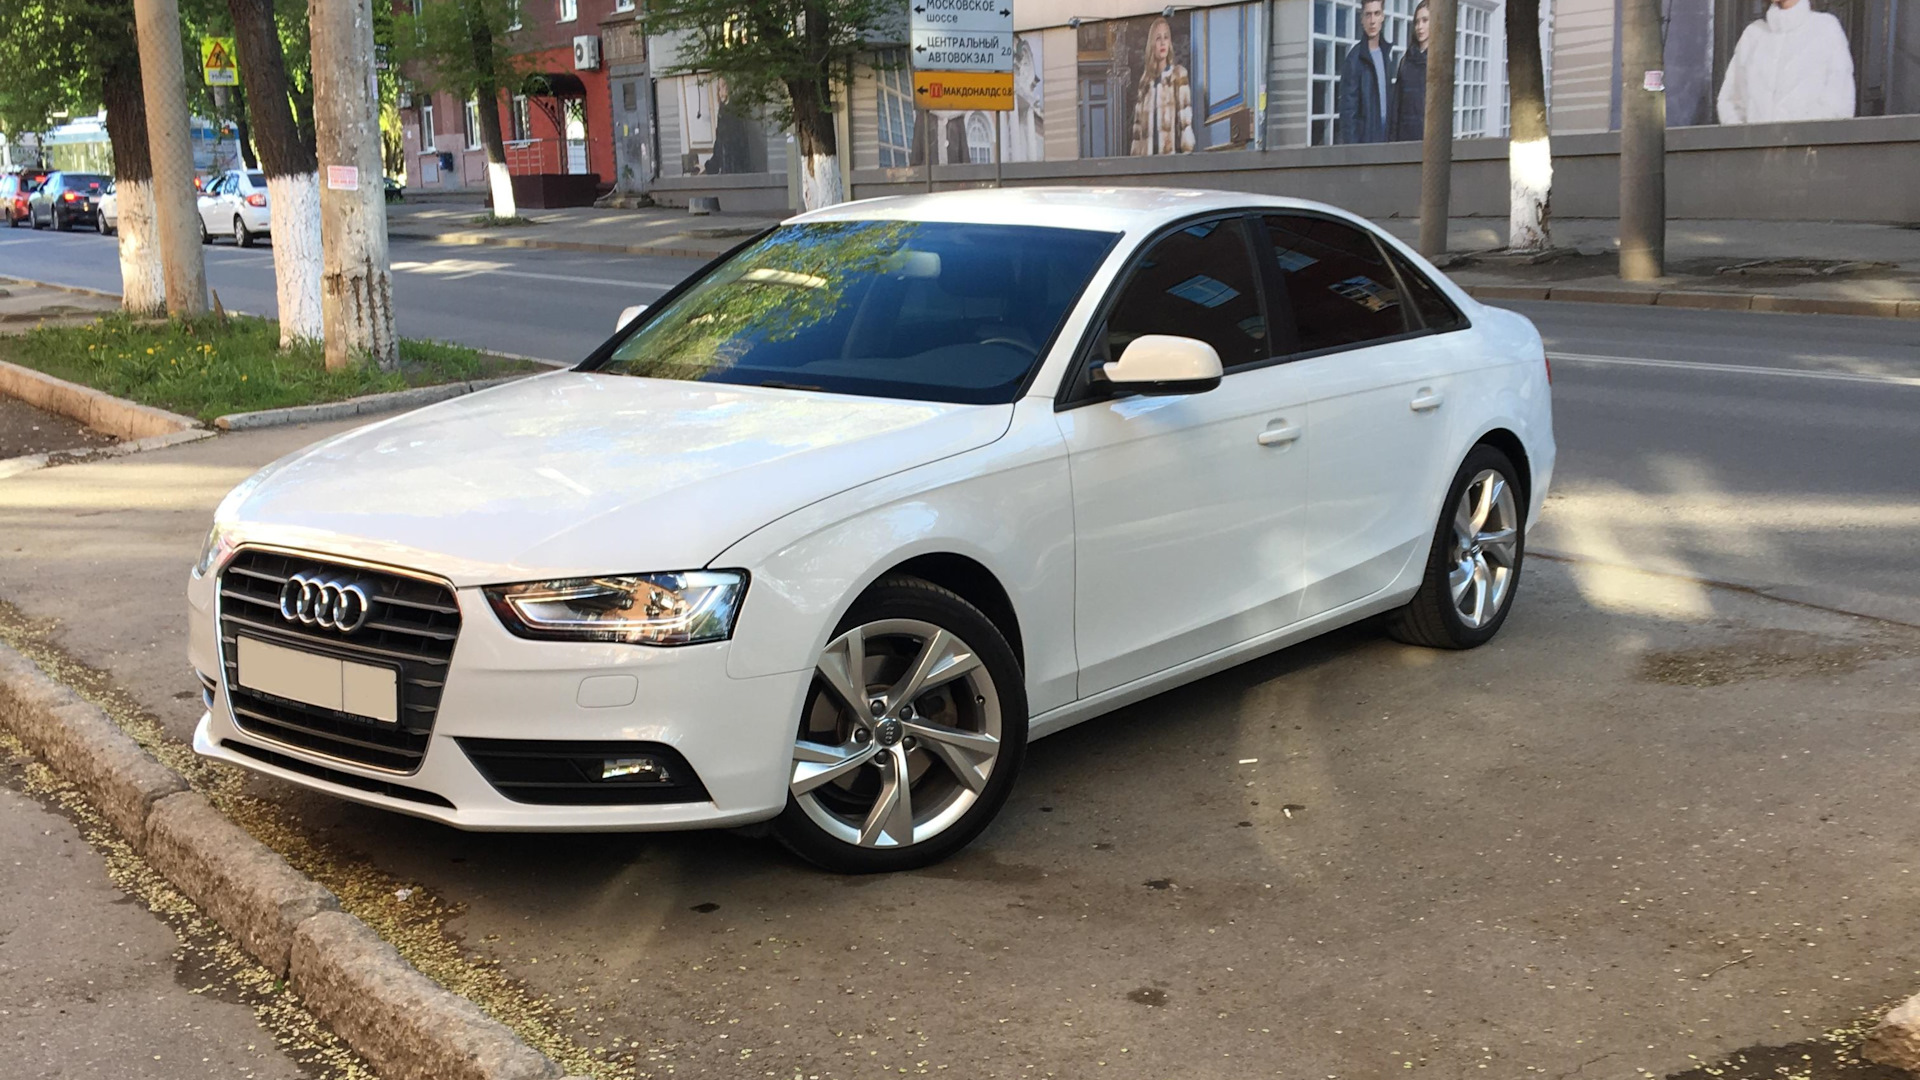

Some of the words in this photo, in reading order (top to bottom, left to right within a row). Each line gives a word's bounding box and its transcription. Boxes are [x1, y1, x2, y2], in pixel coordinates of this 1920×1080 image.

[926, 0, 995, 11] МОСКОВСКОЕ
[926, 14, 958, 23] шоссе
[927, 36, 999, 49] ЦЕНТРАЛЬНЫЙ
[1001, 46, 1012, 56] 2.0
[928, 52, 994, 64] АВТОВОКЗАЛ
[943, 87, 1001, 98] МАКДОНАЛДС
